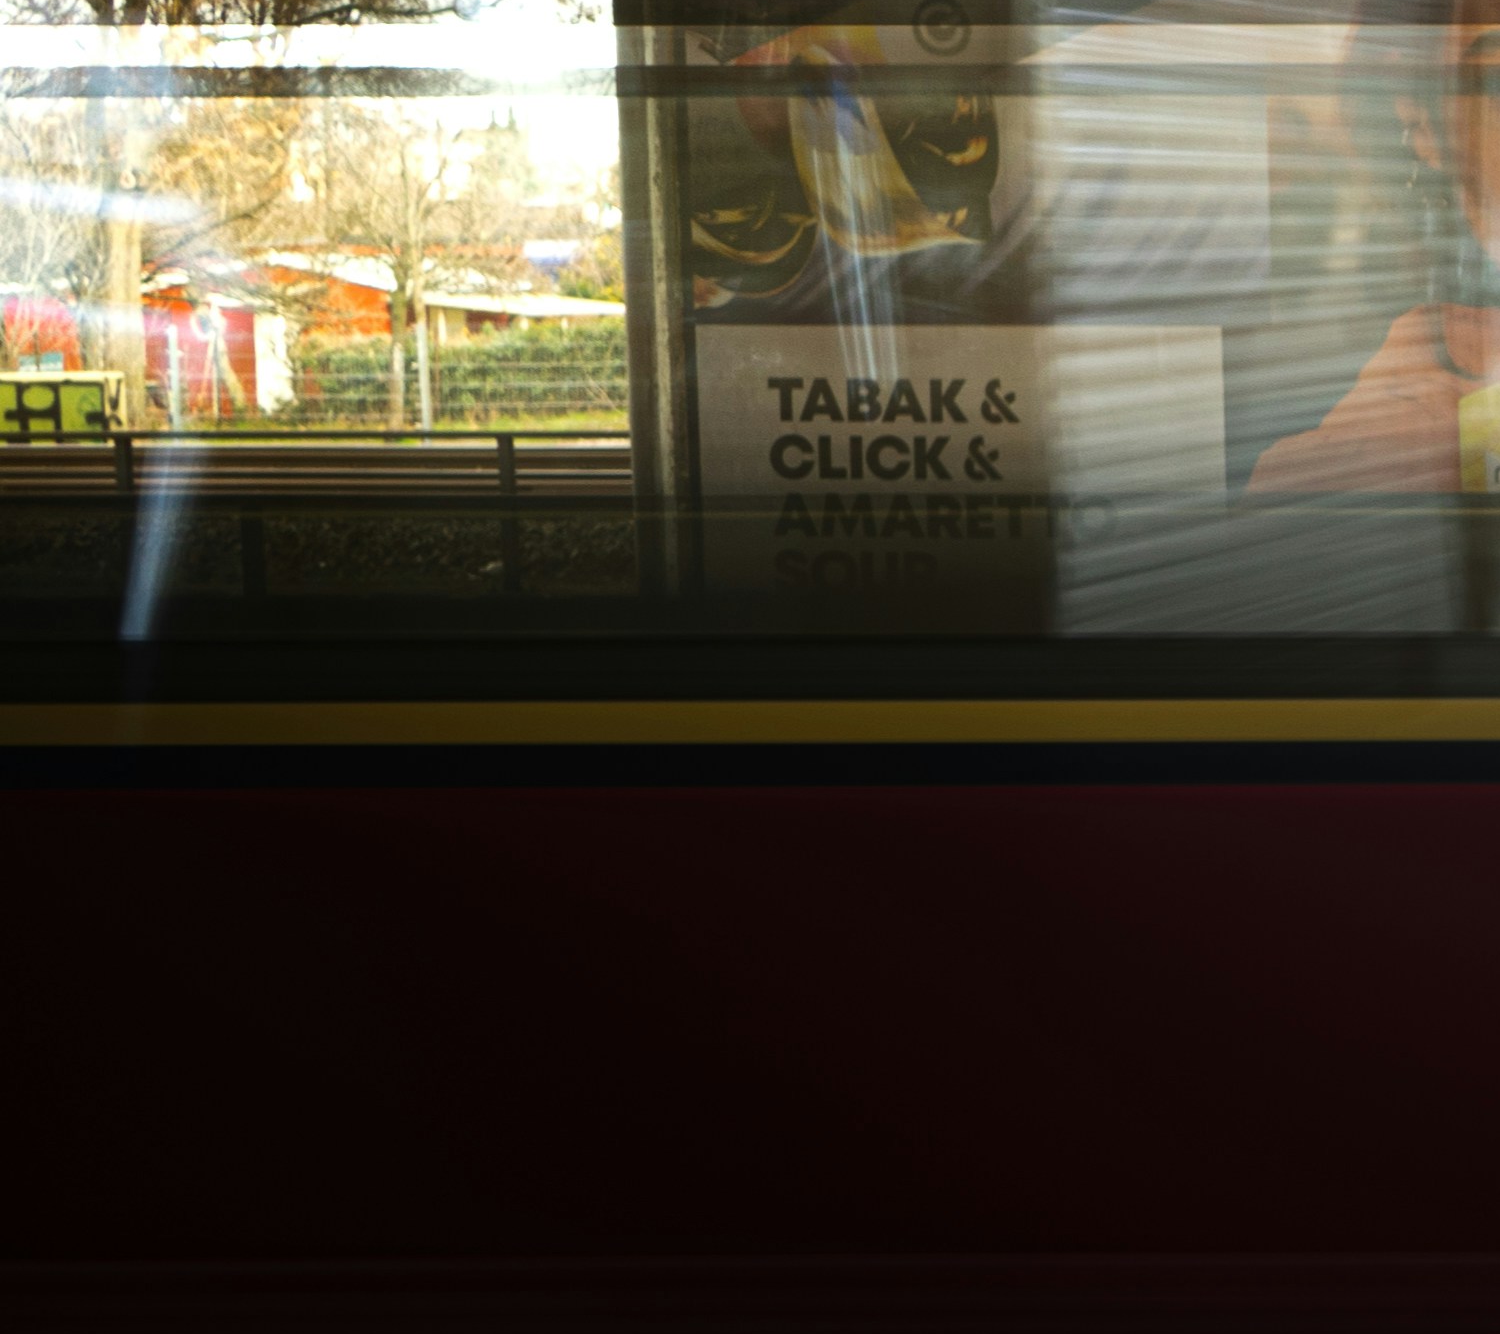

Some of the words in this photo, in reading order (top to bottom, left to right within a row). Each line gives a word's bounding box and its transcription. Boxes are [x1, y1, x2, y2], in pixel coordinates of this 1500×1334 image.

[767, 376, 968, 424] TABAK
[980, 377, 1023, 424] &
[769, 434, 952, 480] CLICK
[963, 434, 1004, 481] &
